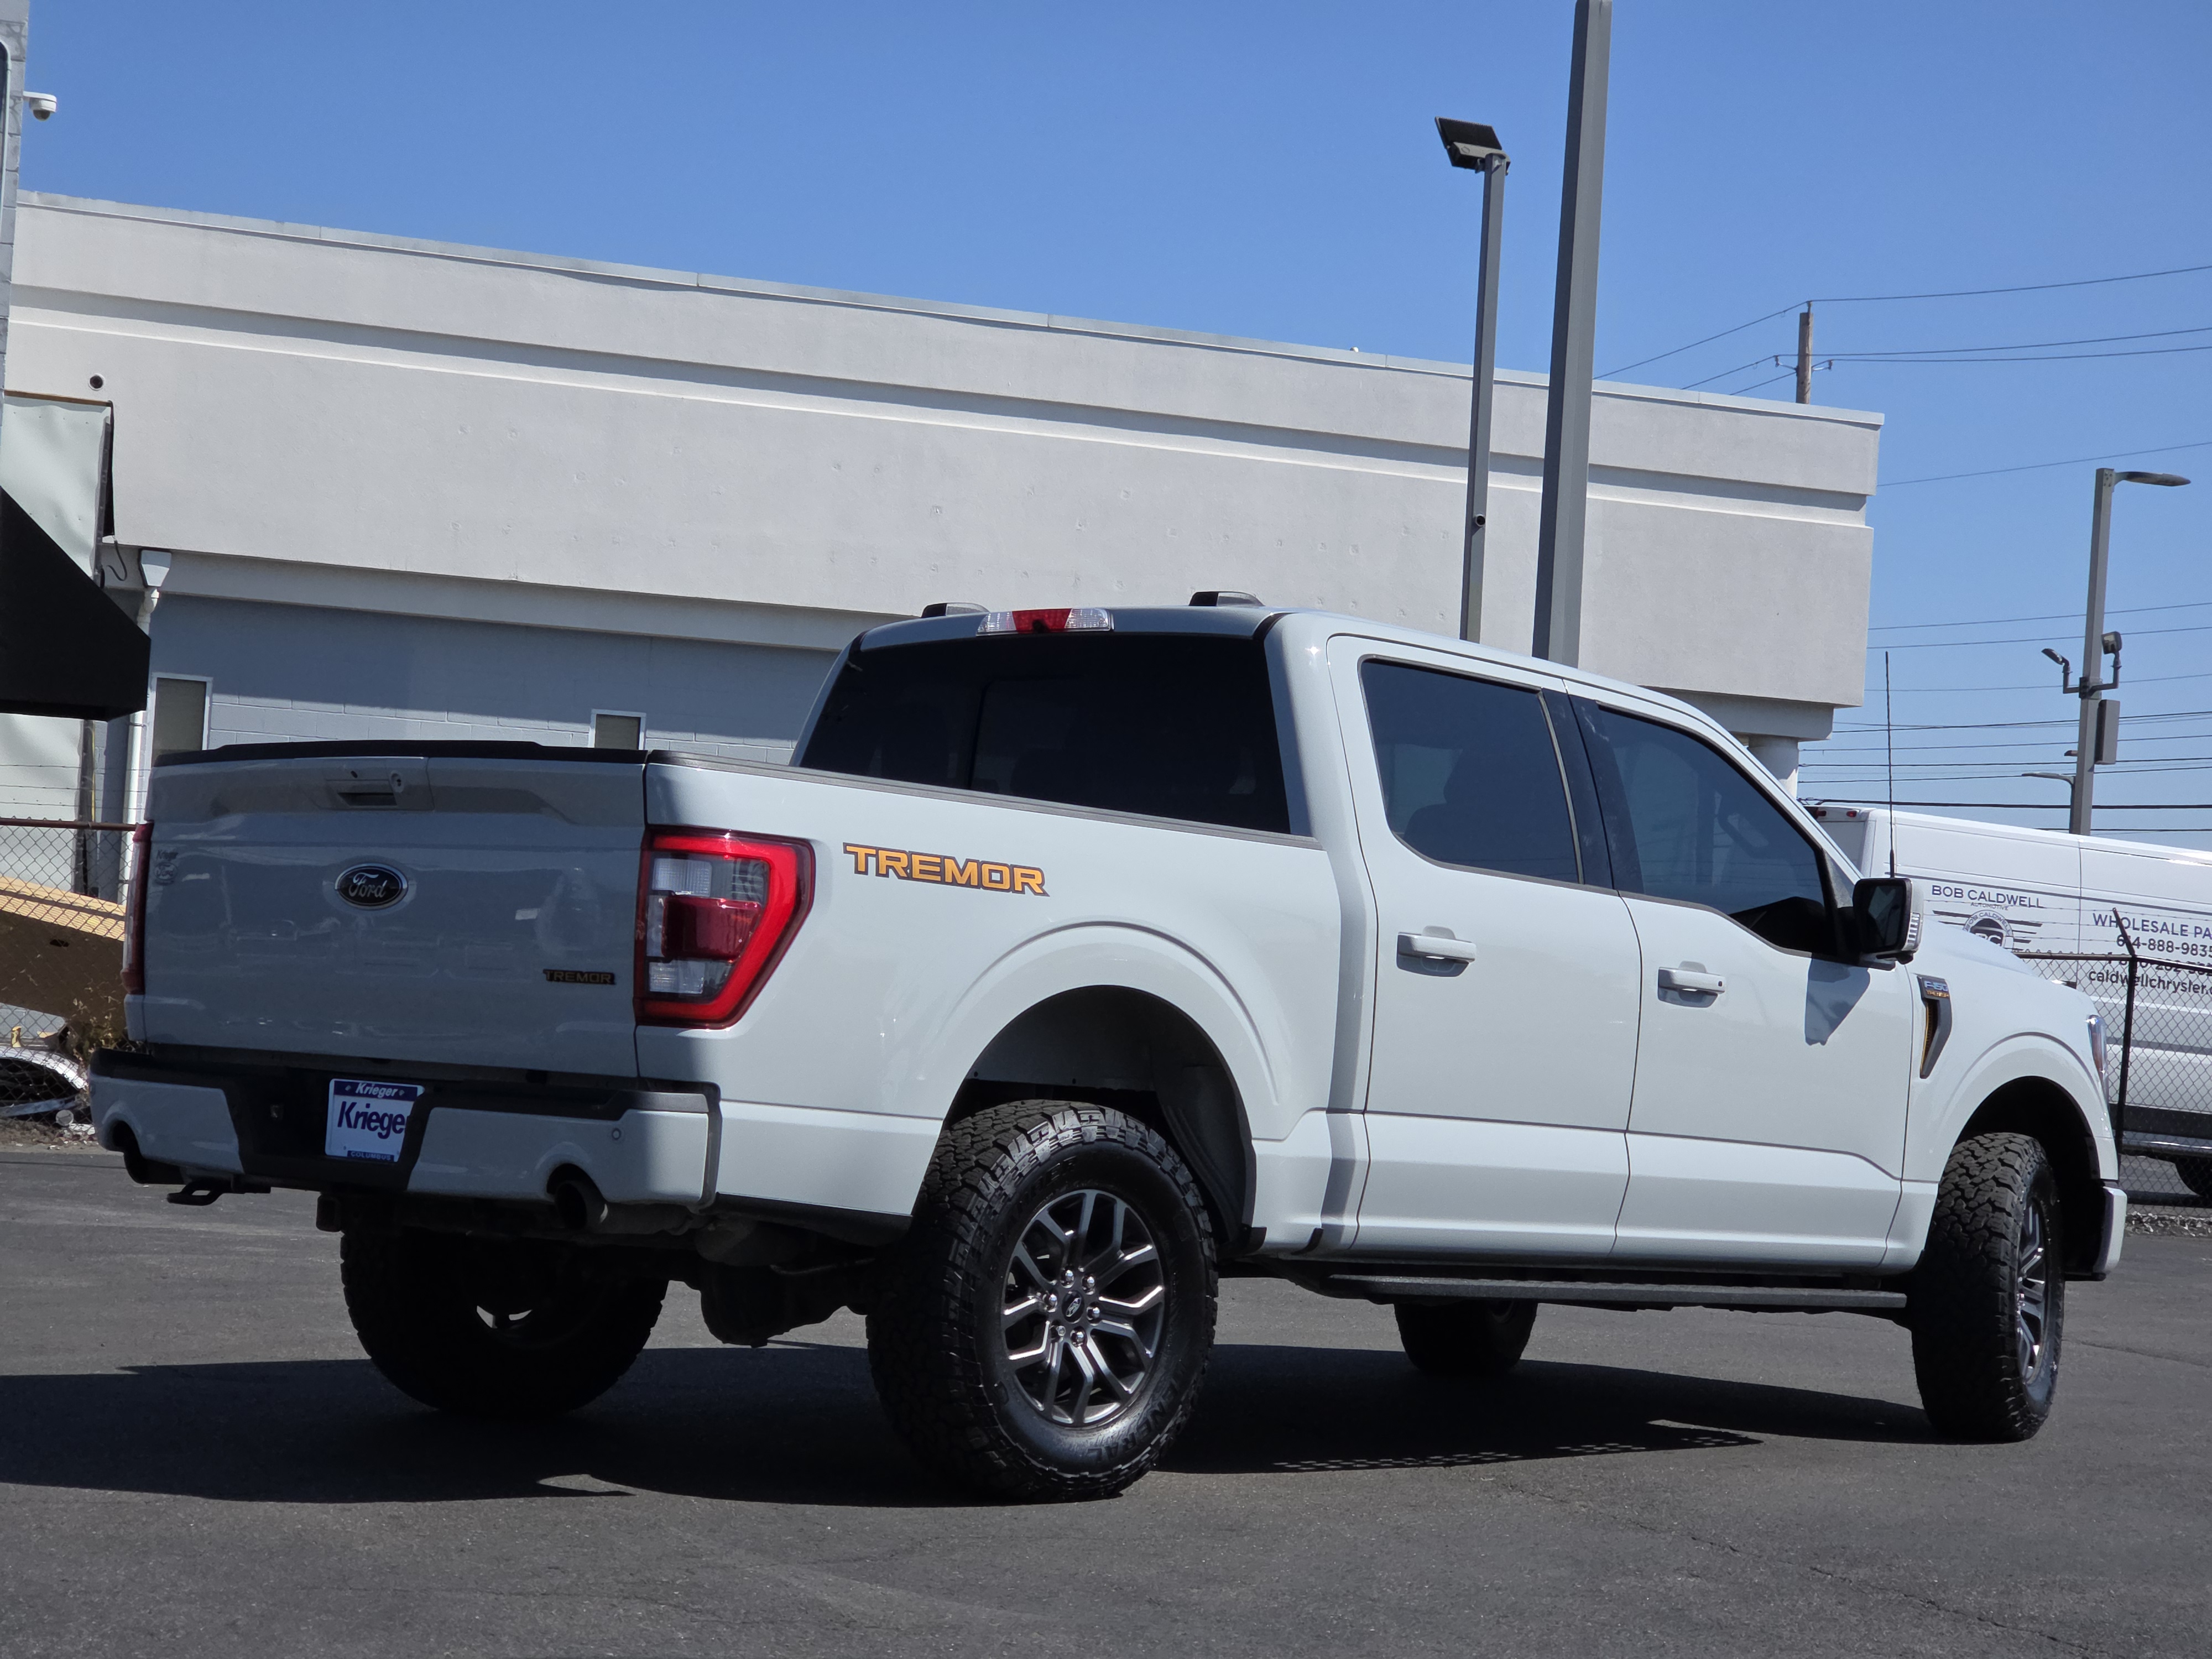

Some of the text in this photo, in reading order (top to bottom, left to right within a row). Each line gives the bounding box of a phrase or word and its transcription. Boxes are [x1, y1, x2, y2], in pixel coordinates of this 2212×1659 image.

[843, 842, 1050, 897] TREMOR
[348, 872, 388, 898] Ford
[1932, 885, 2046, 908] BOB CALDWELL
[1970, 902, 2008, 911] AUTOMOTIVE
[2093, 913, 2189, 937] WHOLESALE
[2117, 934, 2212, 958] 64-888-9835
[544, 969, 614, 984] TREMOR
[355, 1082, 398, 1098] Krieger
[350, 1151, 392, 1161] COLUMBUS
